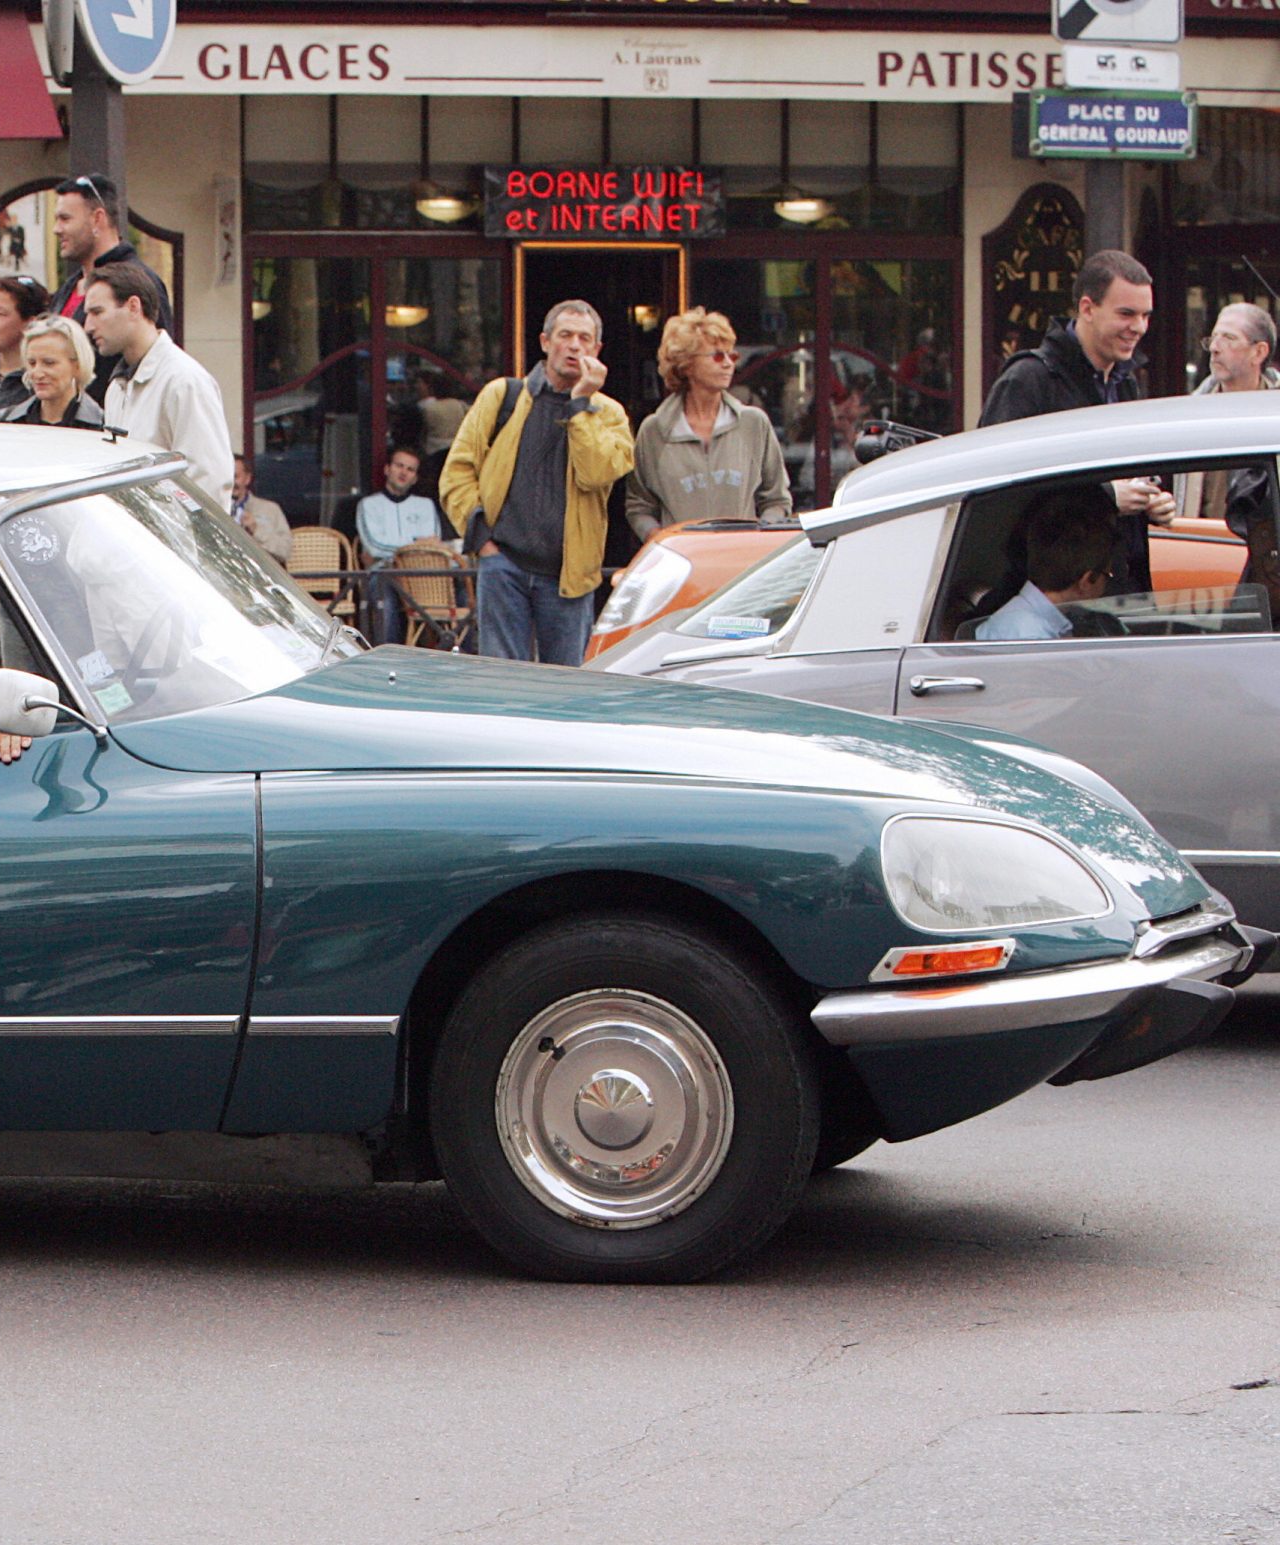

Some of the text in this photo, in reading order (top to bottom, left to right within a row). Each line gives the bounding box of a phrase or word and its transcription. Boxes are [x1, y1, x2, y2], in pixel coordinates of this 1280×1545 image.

[197, 43, 390, 81] GLACES
[634, 51, 702, 65] Laurans
[1068, 104, 1160, 122] PLACE DU
[1038, 124, 1189, 144] GÉNÉRAL GOURAUD
[506, 170, 704, 199] BORNE WIFI
[505, 204, 703, 232] et INTERNET
